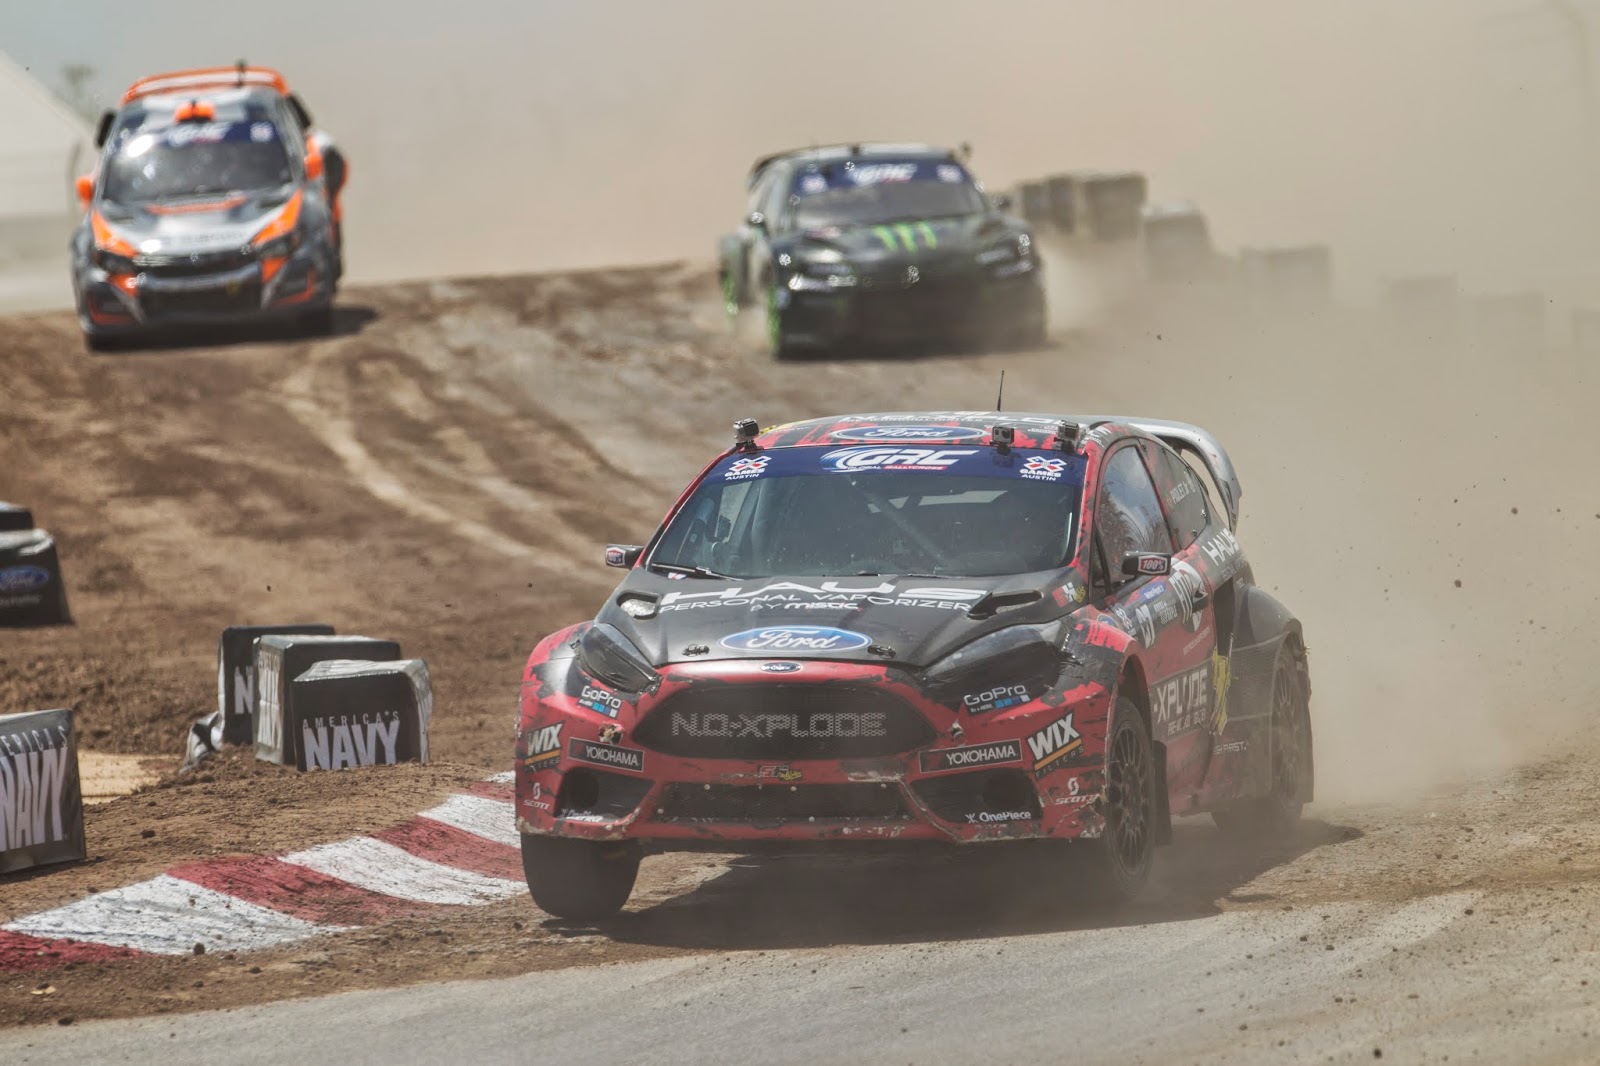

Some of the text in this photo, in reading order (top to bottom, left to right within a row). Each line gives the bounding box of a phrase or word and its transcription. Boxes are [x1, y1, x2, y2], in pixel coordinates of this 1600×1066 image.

[863, 427, 954, 437] Ford
[843, 448, 980, 467] GRC
[725, 473, 760, 481] AUSTIN
[1141, 560, 1165, 570] 100%
[659, 593, 972, 614] PERSONAL VAPORIZER
[660, 581, 988, 606] HAUS
[745, 630, 842, 648] Ford
[581, 685, 622, 709] GoPro
[963, 684, 1027, 706] GoPro
[302, 719, 401, 772] NAVY
[527, 723, 563, 756] WIX
[1027, 713, 1080, 761] WIX
[585, 745, 639, 766] YOKOHAMA
[946, 745, 1017, 765] YOKOHAMA
[1035, 745, 1084, 778] FILTERS
[522, 799, 550, 810] SCOTT
[979, 810, 1031, 822] OnePiece
